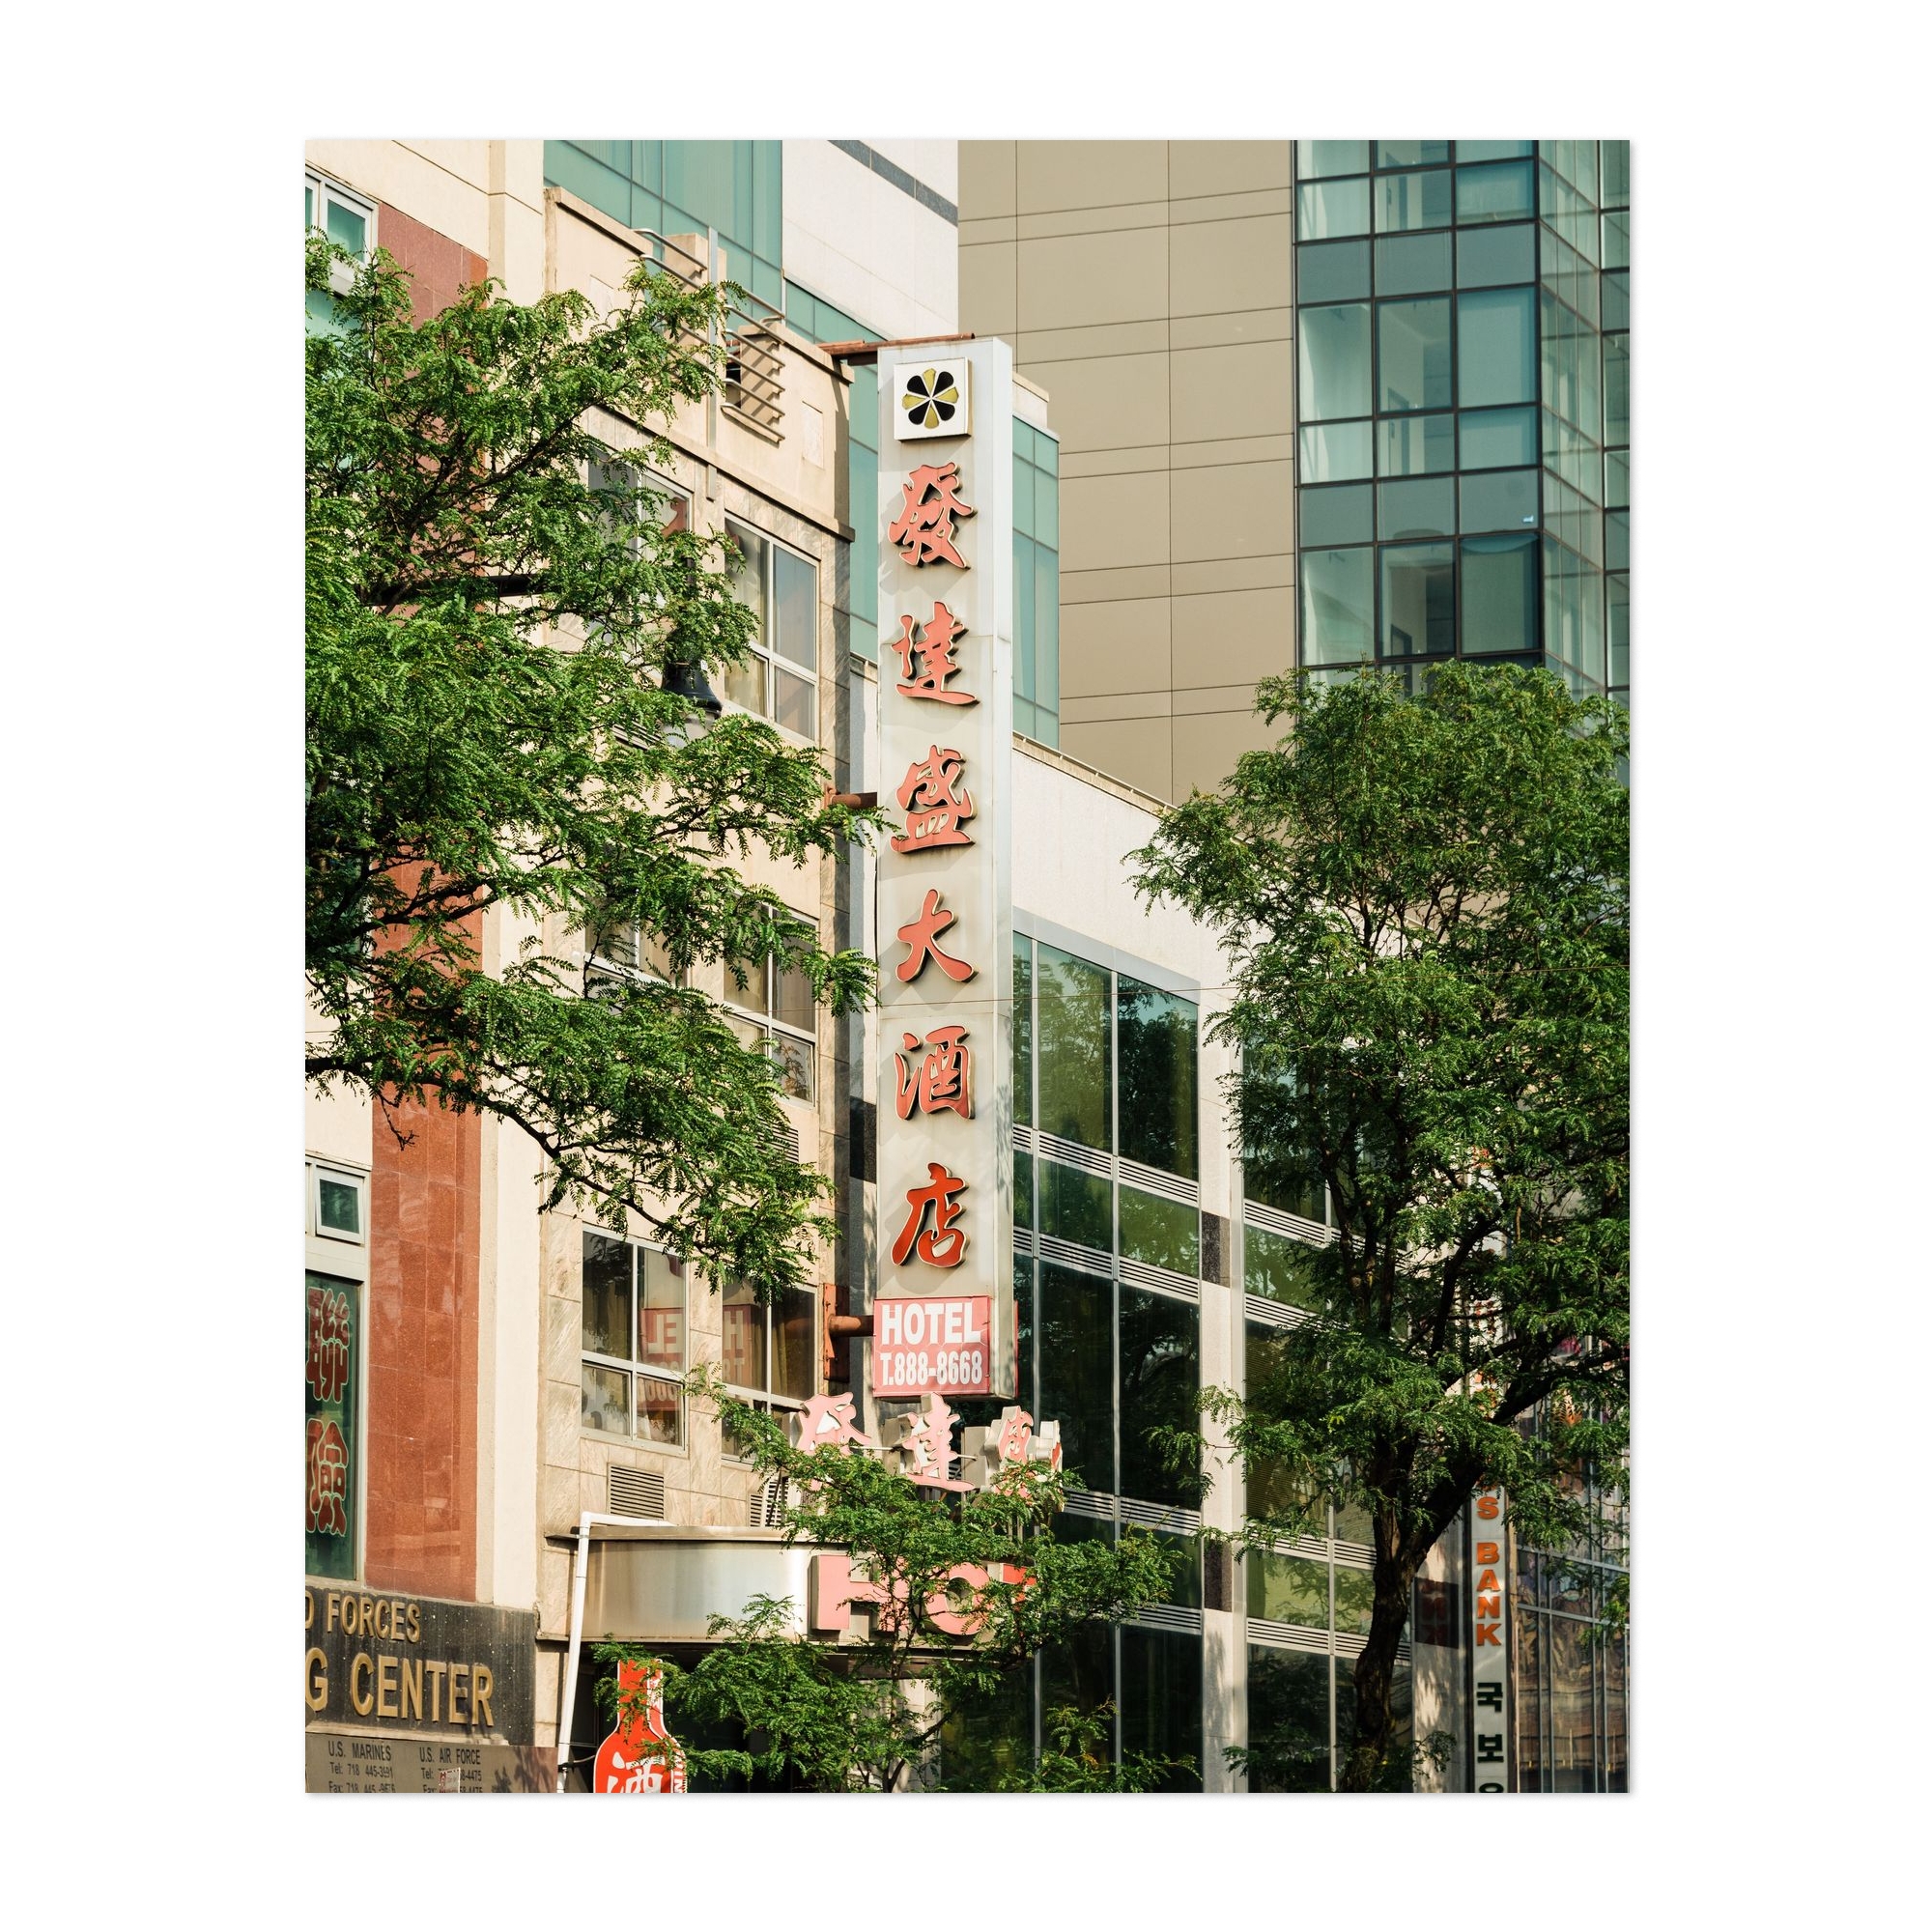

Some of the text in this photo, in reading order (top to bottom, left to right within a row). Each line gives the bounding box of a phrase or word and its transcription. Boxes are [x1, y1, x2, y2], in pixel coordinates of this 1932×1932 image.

[881, 1301, 983, 1346] HOTEL
[879, 1350, 983, 1389] T.888-8668
[1475, 1542, 1502, 1647] BANK
[327, 1593, 421, 1643] FORCES
[351, 1652, 495, 1727] CENTER
[327, 1741, 392, 1761] U.S. MARINES
[347, 1763, 360, 1776] 718
[419, 1747, 481, 1765] U.S. AIR FORCE
